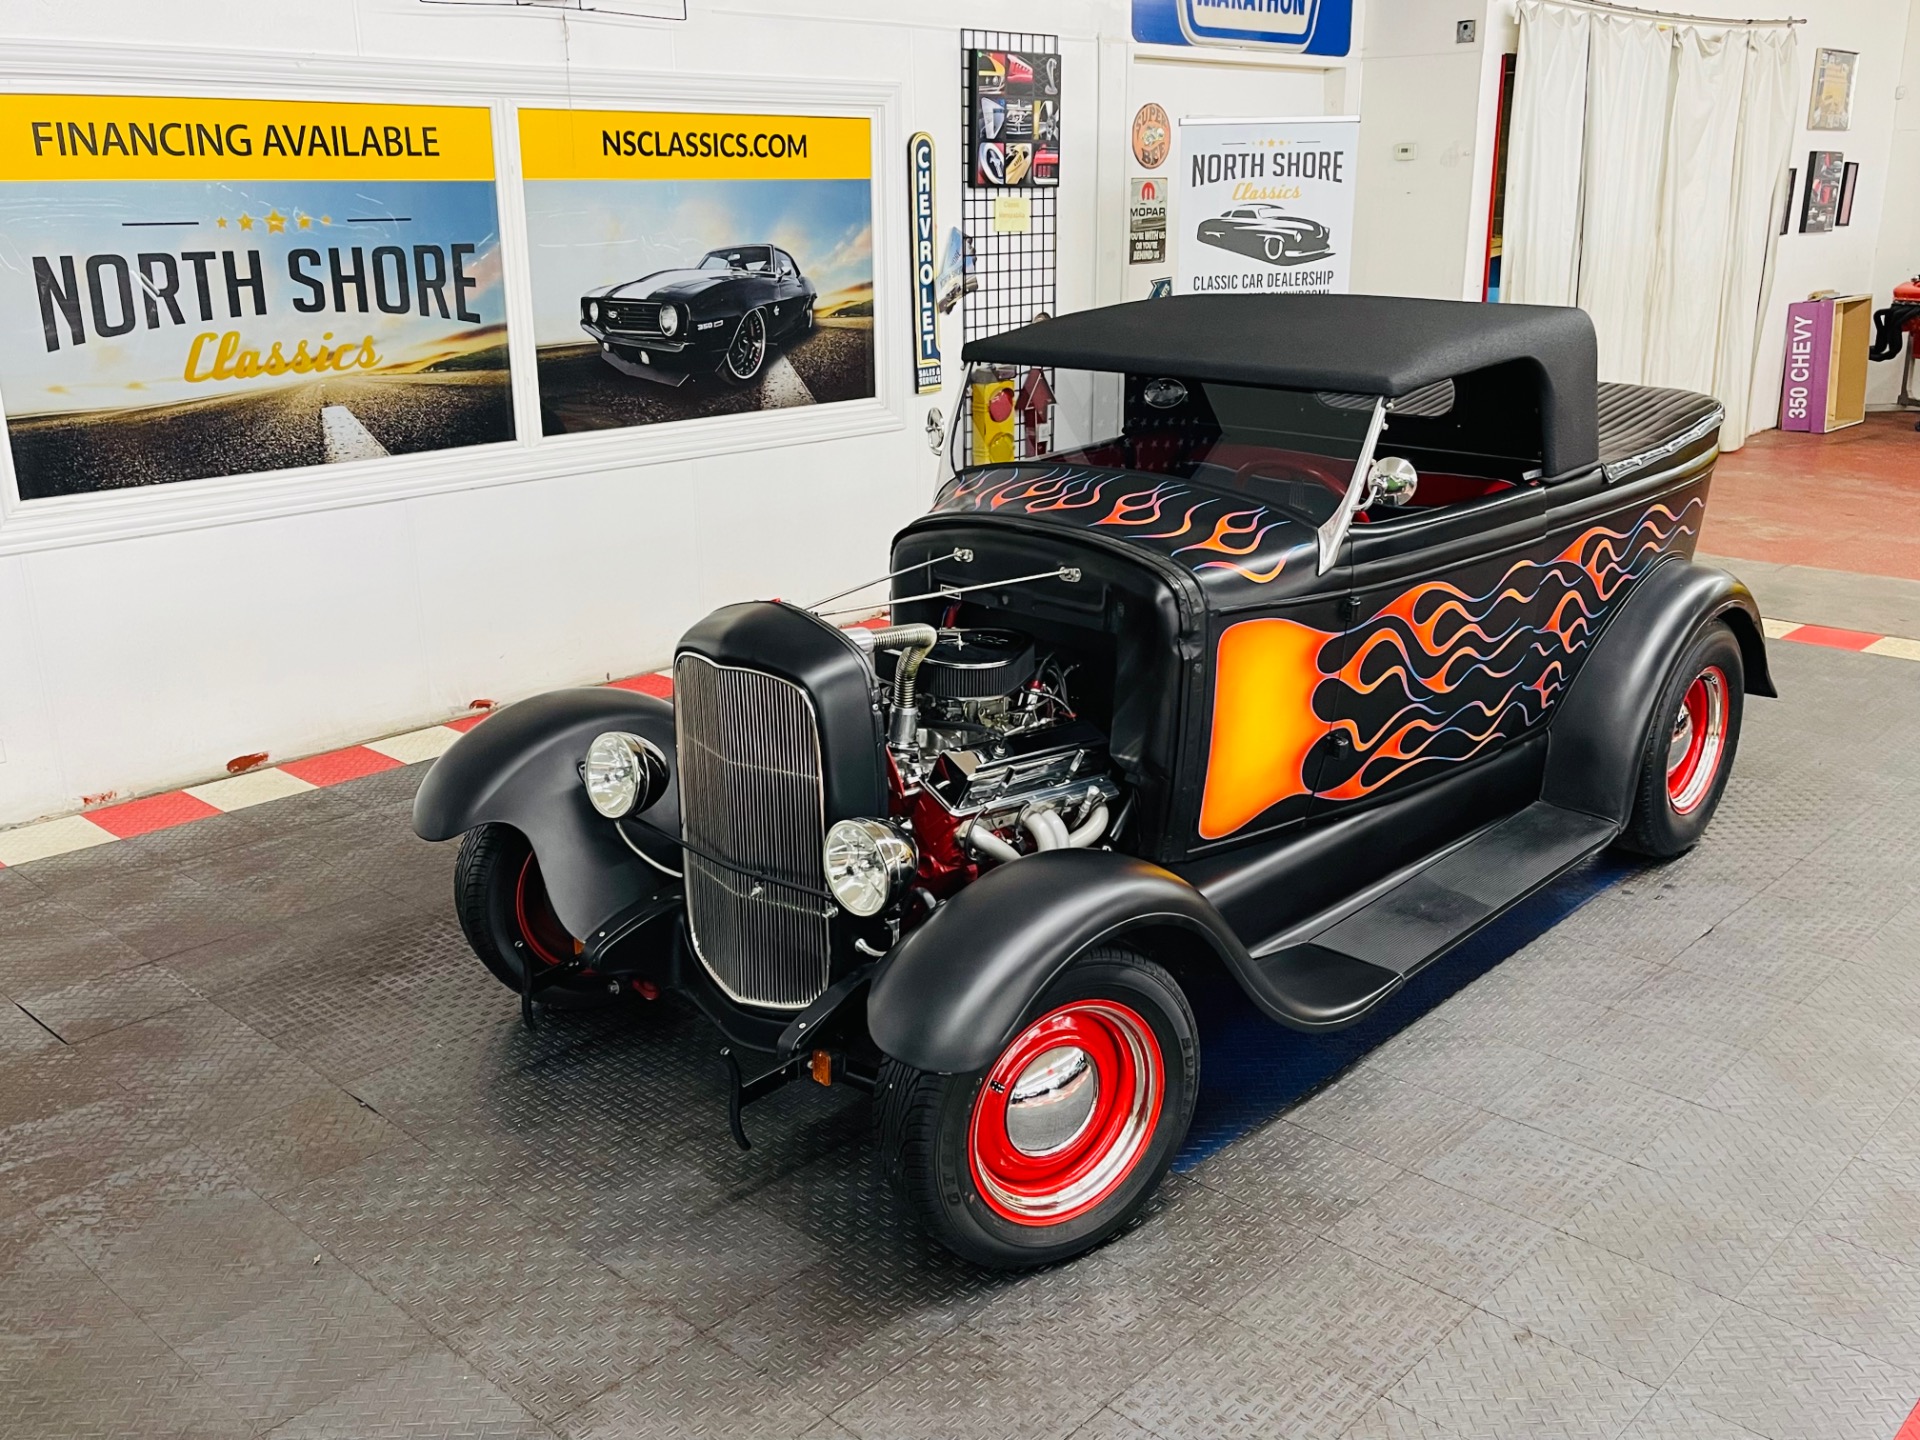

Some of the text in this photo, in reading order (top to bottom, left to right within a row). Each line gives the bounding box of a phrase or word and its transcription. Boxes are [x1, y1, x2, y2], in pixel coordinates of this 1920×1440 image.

[31, 120, 440, 158] FINANCING AVAILABLE
[1135, 106, 1168, 141] SUPER
[601, 130, 808, 158] NSCLASSICS.COM
[1141, 142, 1165, 166] BEE
[1192, 151, 1344, 187] NORTH SHORE
[1232, 182, 1302, 201] Classics
[1130, 207, 1165, 217] MOPAR
[917, 146, 935, 355] CHEVROLET
[32, 243, 481, 353] NORTH SHORE
[1193, 270, 1334, 291] CLASSIC CAR DEALERSHIP
[183, 331, 384, 383] Classics
[1788, 315, 1813, 419] 350 CHEVY
